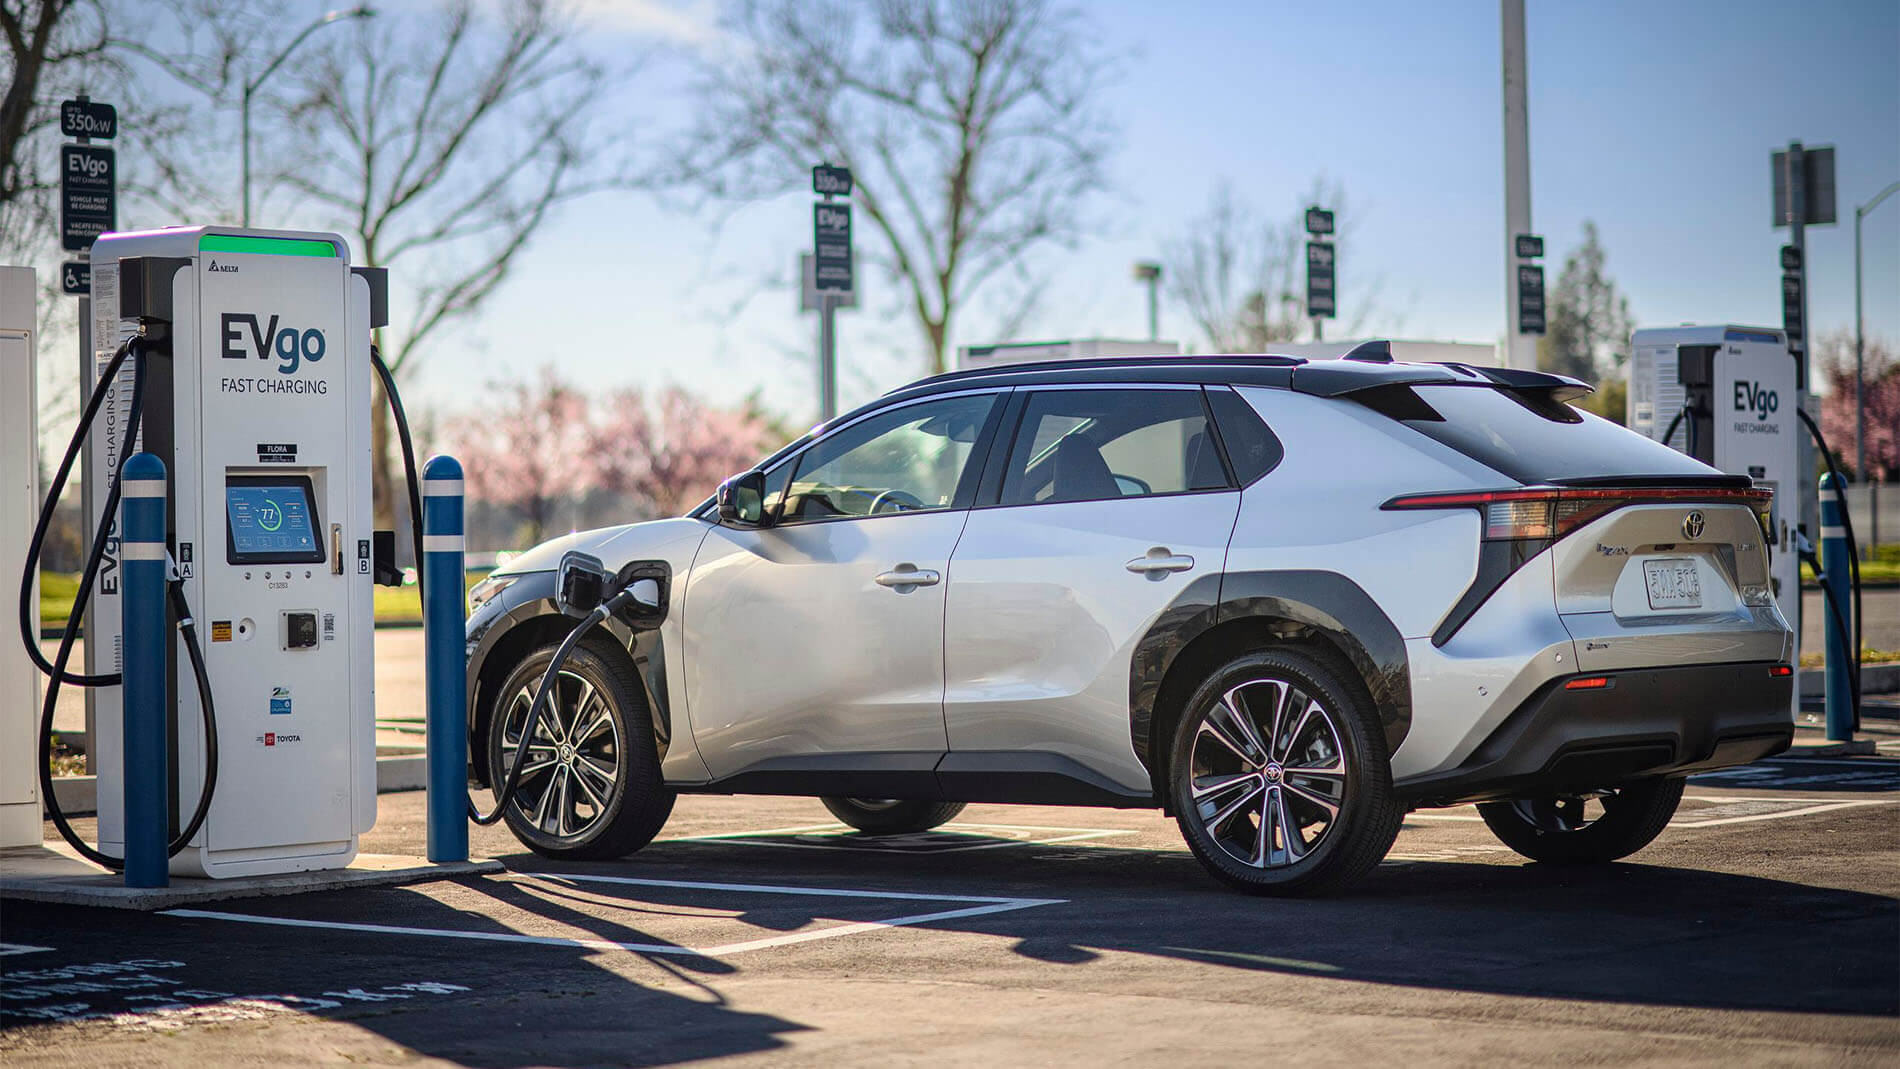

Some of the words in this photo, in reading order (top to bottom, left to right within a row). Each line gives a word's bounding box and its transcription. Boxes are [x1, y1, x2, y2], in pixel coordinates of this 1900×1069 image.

[66, 113, 112, 133] 350kW
[69, 153, 108, 178] EVgo
[221, 312, 326, 375] EVgo
[221, 378, 254, 393] FAST
[257, 378, 327, 395] CHARGING
[1734, 380, 1778, 421] EVgo
[106, 388, 116, 467] CHARGING
[267, 445, 288, 453] FLORA
[182, 563, 191, 576] A
[360, 559, 368, 571] B
[277, 735, 301, 743] TOYOTA
